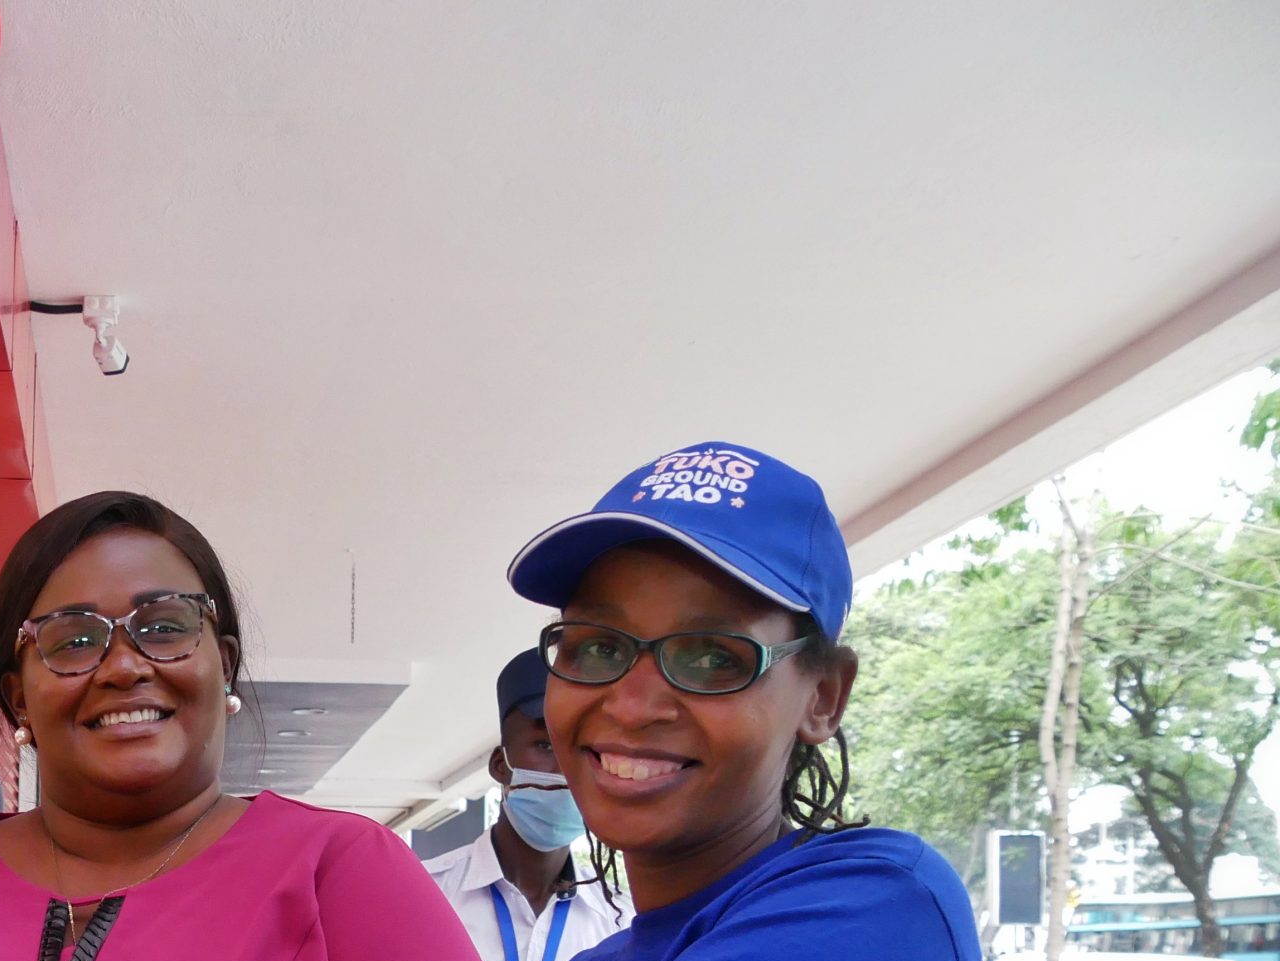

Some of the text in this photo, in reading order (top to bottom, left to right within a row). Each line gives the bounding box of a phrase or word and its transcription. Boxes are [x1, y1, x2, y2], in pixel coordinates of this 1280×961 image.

[654, 455, 755, 480] TUKO
[640, 470, 748, 493] GROUND
[651, 483, 722, 504] TAO
